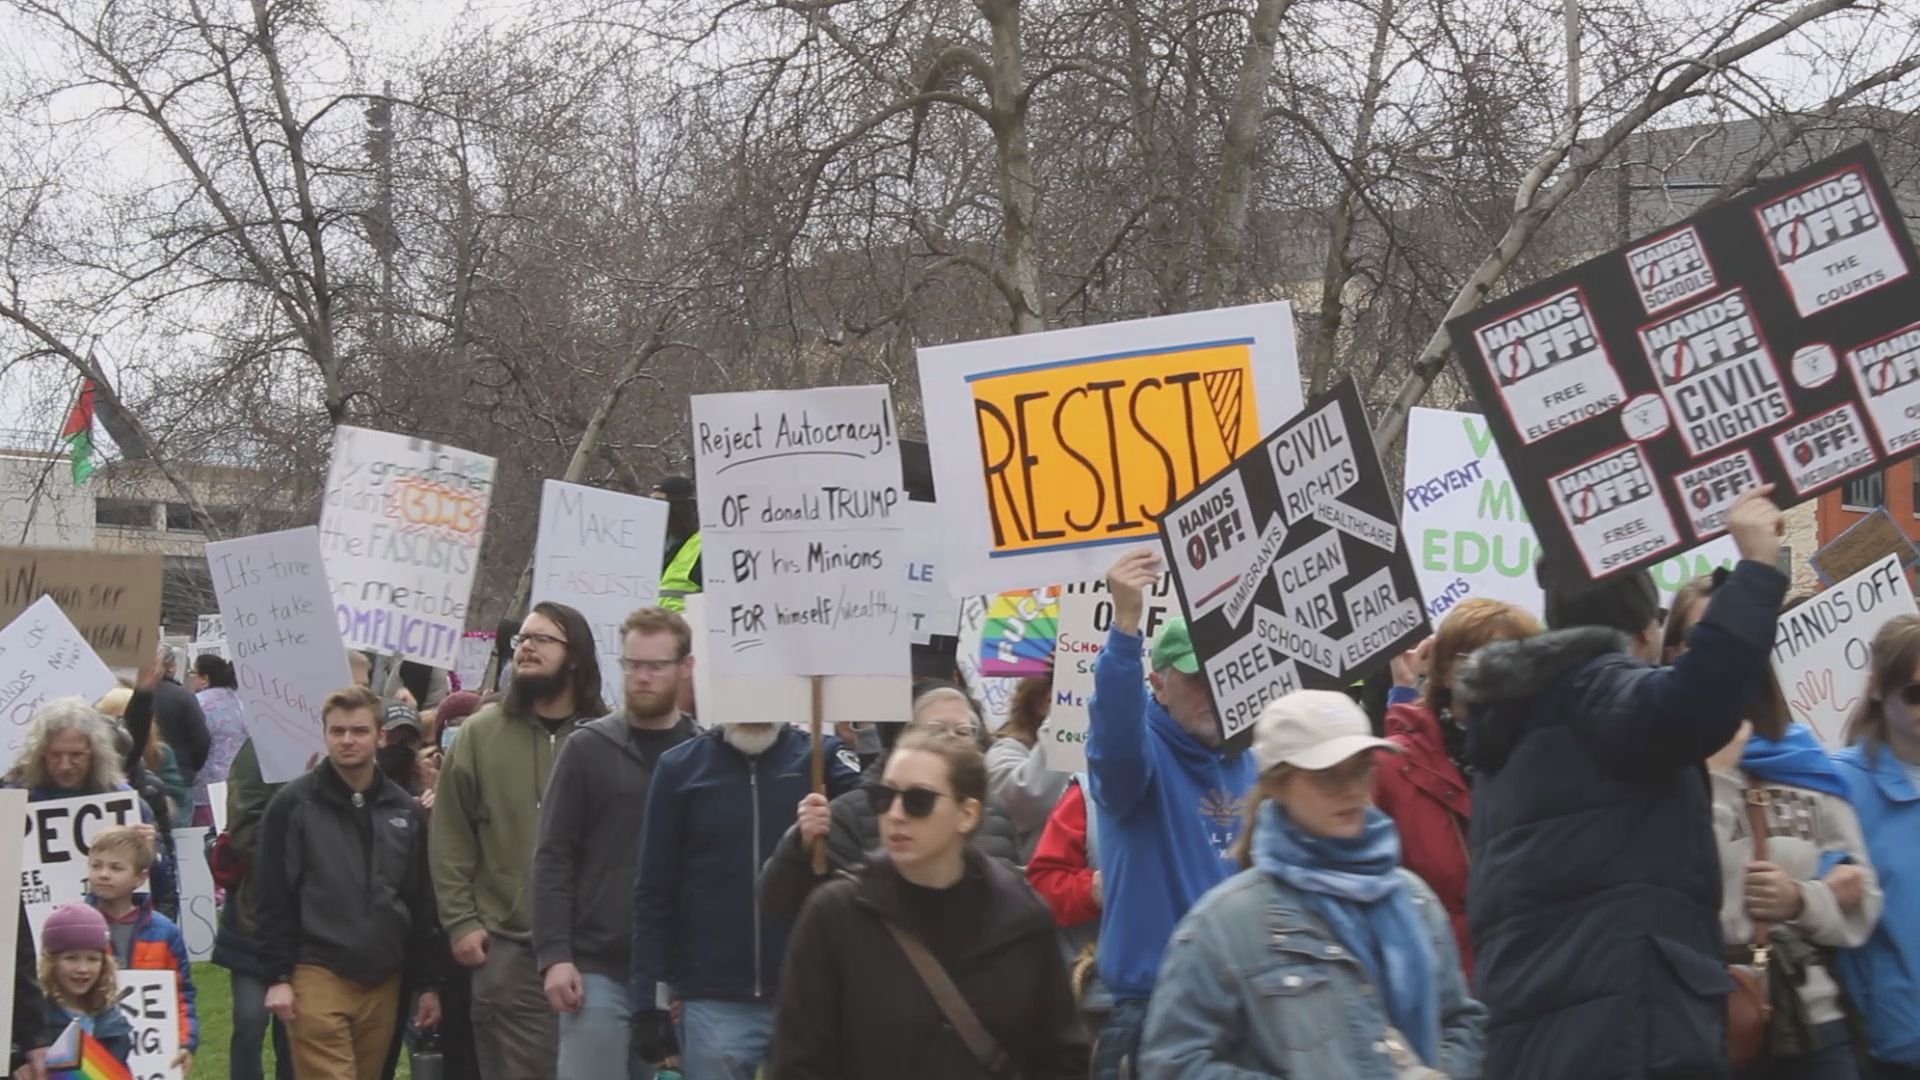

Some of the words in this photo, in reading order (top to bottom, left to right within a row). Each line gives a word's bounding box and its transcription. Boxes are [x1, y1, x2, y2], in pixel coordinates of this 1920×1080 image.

[1763, 173, 1862, 228] HANDS
[1632, 234, 1694, 268] HANDS
[1776, 194, 1877, 262] OFF!
[1639, 251, 1704, 290] OFF!
[1645, 270, 1713, 308] SCHOOLS
[1816, 269, 1886, 306] COURTS
[1823, 255, 1860, 277] THE
[1484, 296, 1581, 349] HANDS
[1647, 295, 1745, 349] HANDS
[1497, 317, 1595, 382] OFF!
[1660, 315, 1759, 380] OFF!
[1543, 382, 1587, 408] FREE
[1675, 358, 1779, 423] CIVIL
[700, 412, 762, 459] Reject
[775, 398, 892, 456] Autocracy!
[1527, 394, 1620, 440] ELECTIONS
[1690, 392, 1788, 450] RIGHTS
[1784, 410, 1849, 446] HANDS
[1274, 414, 1343, 476] CIVIL
[1793, 423, 1859, 468] OFF!
[1797, 447, 1873, 488] MEDICARE
[1287, 458, 1355, 521] RIGHTS
[1406, 460, 1483, 512] PREVENT
[1559, 451, 1639, 494] HANDS
[1683, 454, 1747, 489] HANDS
[1691, 469, 1757, 511] OFF!
[551, 487, 637, 549] MAKE
[761, 496, 820, 524] donald
[822, 486, 898, 522] TRUMP
[1178, 486, 1234, 538] HANDS
[1569, 467, 1651, 523] OFF!
[1186, 508, 1247, 570] OFF!
[1317, 503, 1393, 547] HEALTHCARE
[1604, 517, 1647, 544] FREE
[368, 523, 471, 575] FASCISTS
[772, 548, 801, 575] his
[808, 542, 883, 574] Minions
[1281, 543, 1342, 594] CLEAN
[1601, 535, 1666, 570] SPEECH
[215, 552, 261, 595] It's
[268, 551, 312, 579] time
[547, 555, 655, 600] FASCISTS
[908, 562, 935, 583] LE
[1226, 525, 1283, 620] IMMIGRANTS
[234, 607, 258, 629] to
[269, 597, 313, 622] take
[361, 580, 410, 608] me
[414, 577, 433, 614] to
[440, 582, 467, 620] be
[1295, 594, 1335, 629] AIR
[1351, 582, 1392, 628] FAIR
[1773, 590, 1853, 664] HANDS
[1856, 558, 1900, 613] OFF
[238, 632, 270, 658] out
[276, 628, 307, 649] the
[336, 603, 457, 662] OMPLICIT!
[1258, 618, 1333, 669] SCHOOLS
[1346, 609, 1418, 663] ELECTIONS
[1213, 642, 1270, 698] FREE
